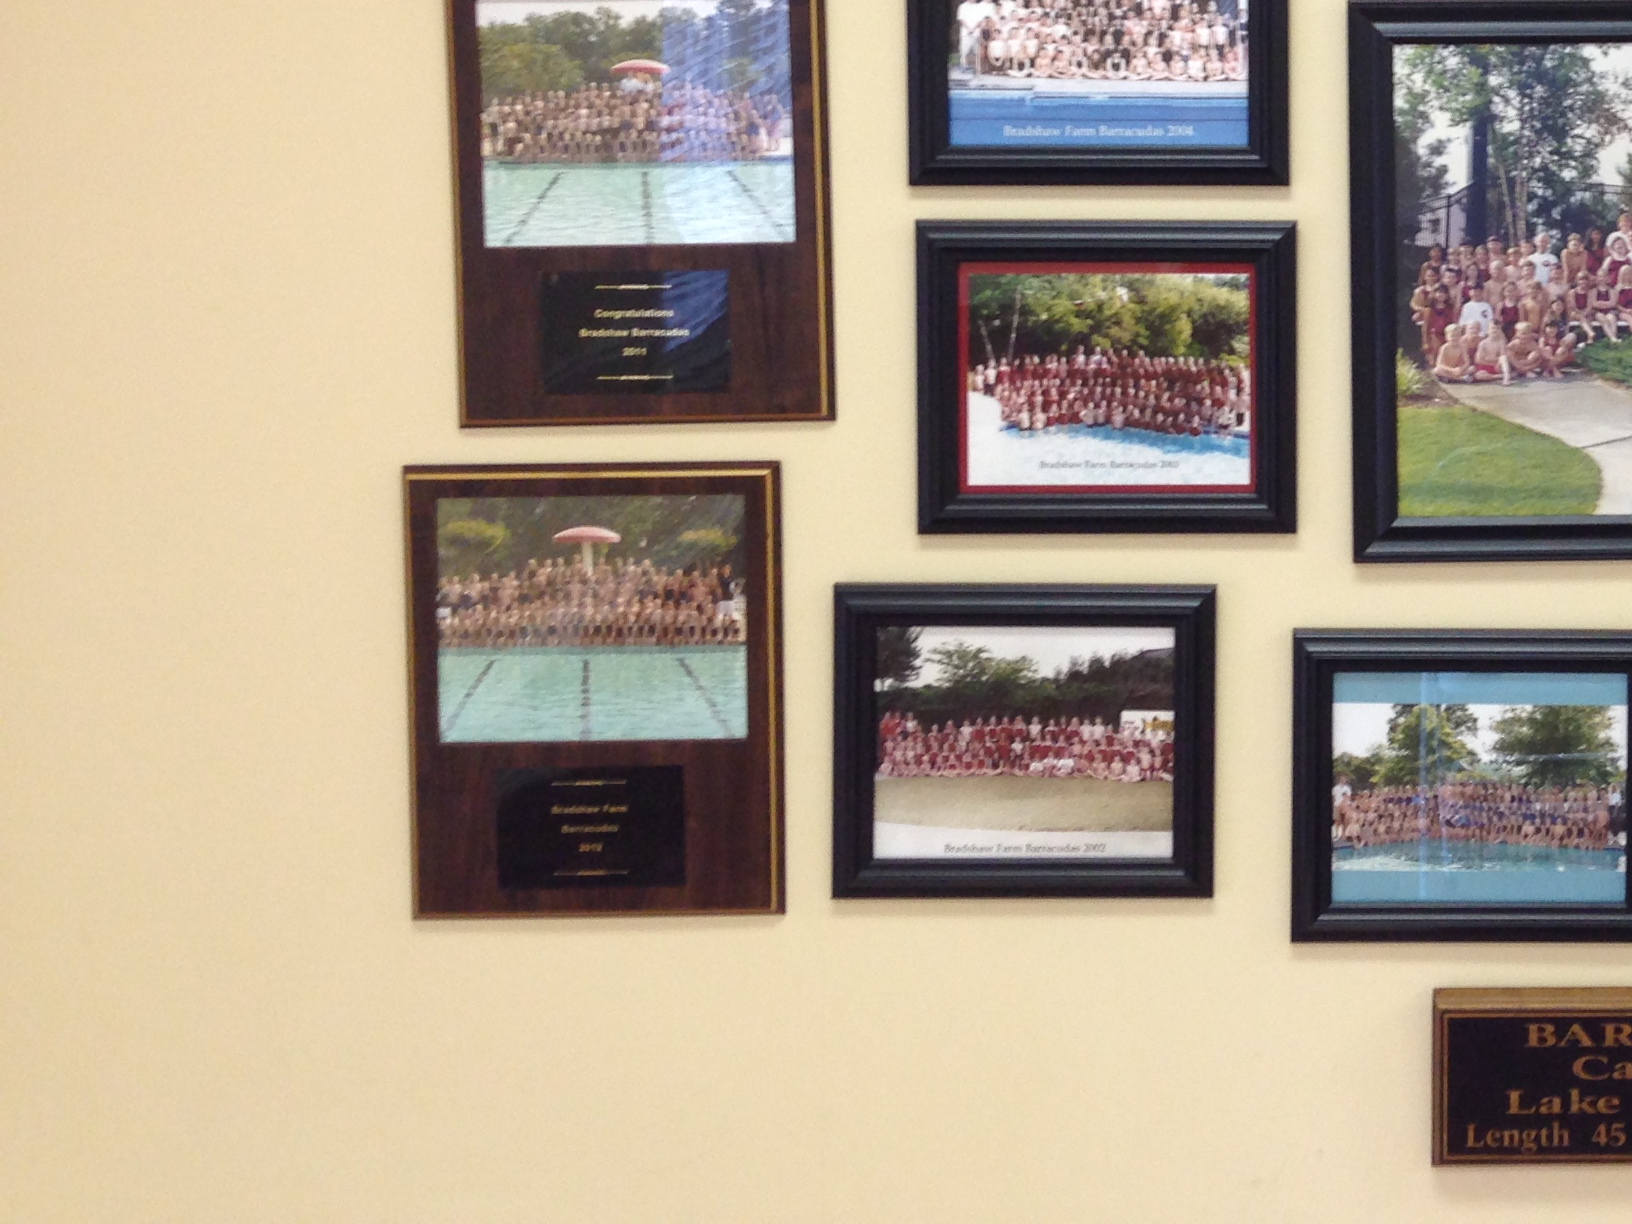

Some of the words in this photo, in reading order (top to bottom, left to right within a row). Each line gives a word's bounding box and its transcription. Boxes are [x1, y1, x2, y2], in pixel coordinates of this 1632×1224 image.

[593, 309, 675, 320] Congratulations
[1505, 1088, 1621, 1115] Lake
[1466, 1122, 1570, 1151] Length
[1591, 1123, 1627, 1147] 45
